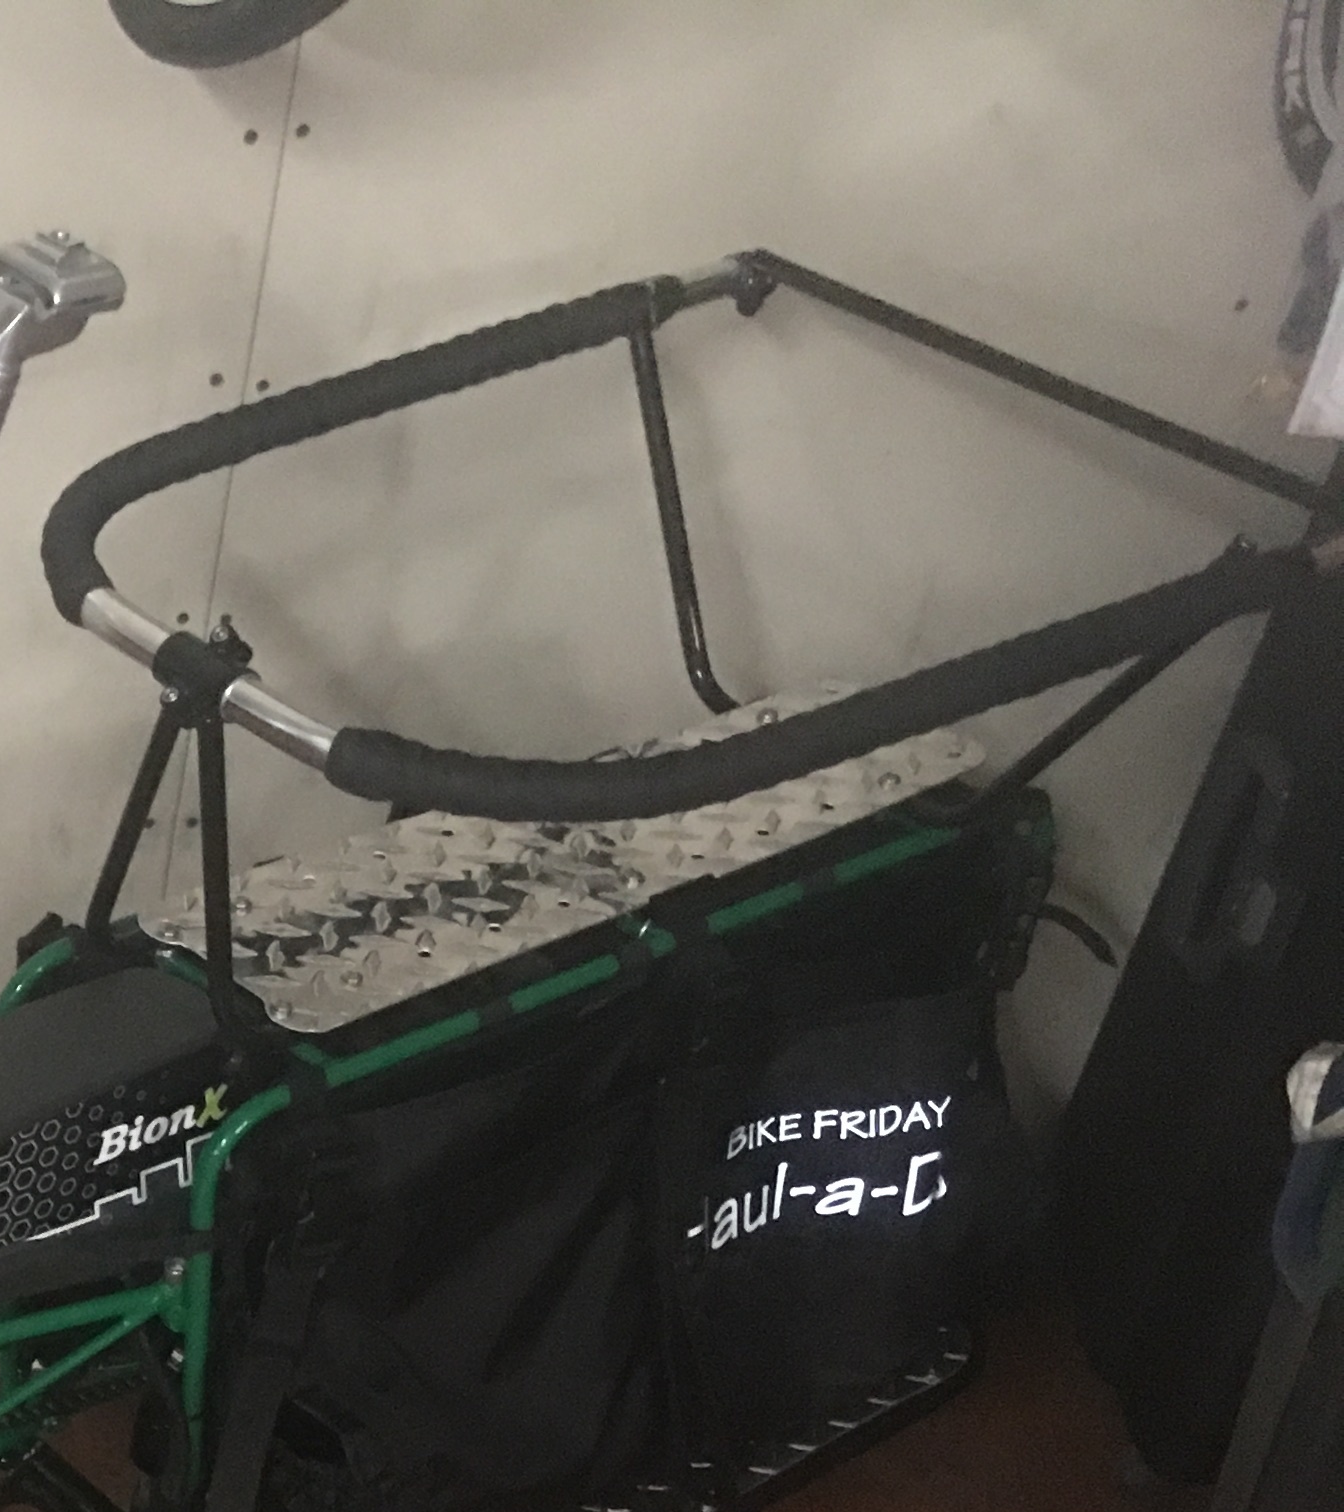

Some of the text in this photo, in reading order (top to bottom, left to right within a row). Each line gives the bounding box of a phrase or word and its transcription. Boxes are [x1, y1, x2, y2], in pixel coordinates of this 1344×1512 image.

[93, 1083, 229, 1166] BionX
[727, 1096, 952, 1160] BIKE FRIDAY
